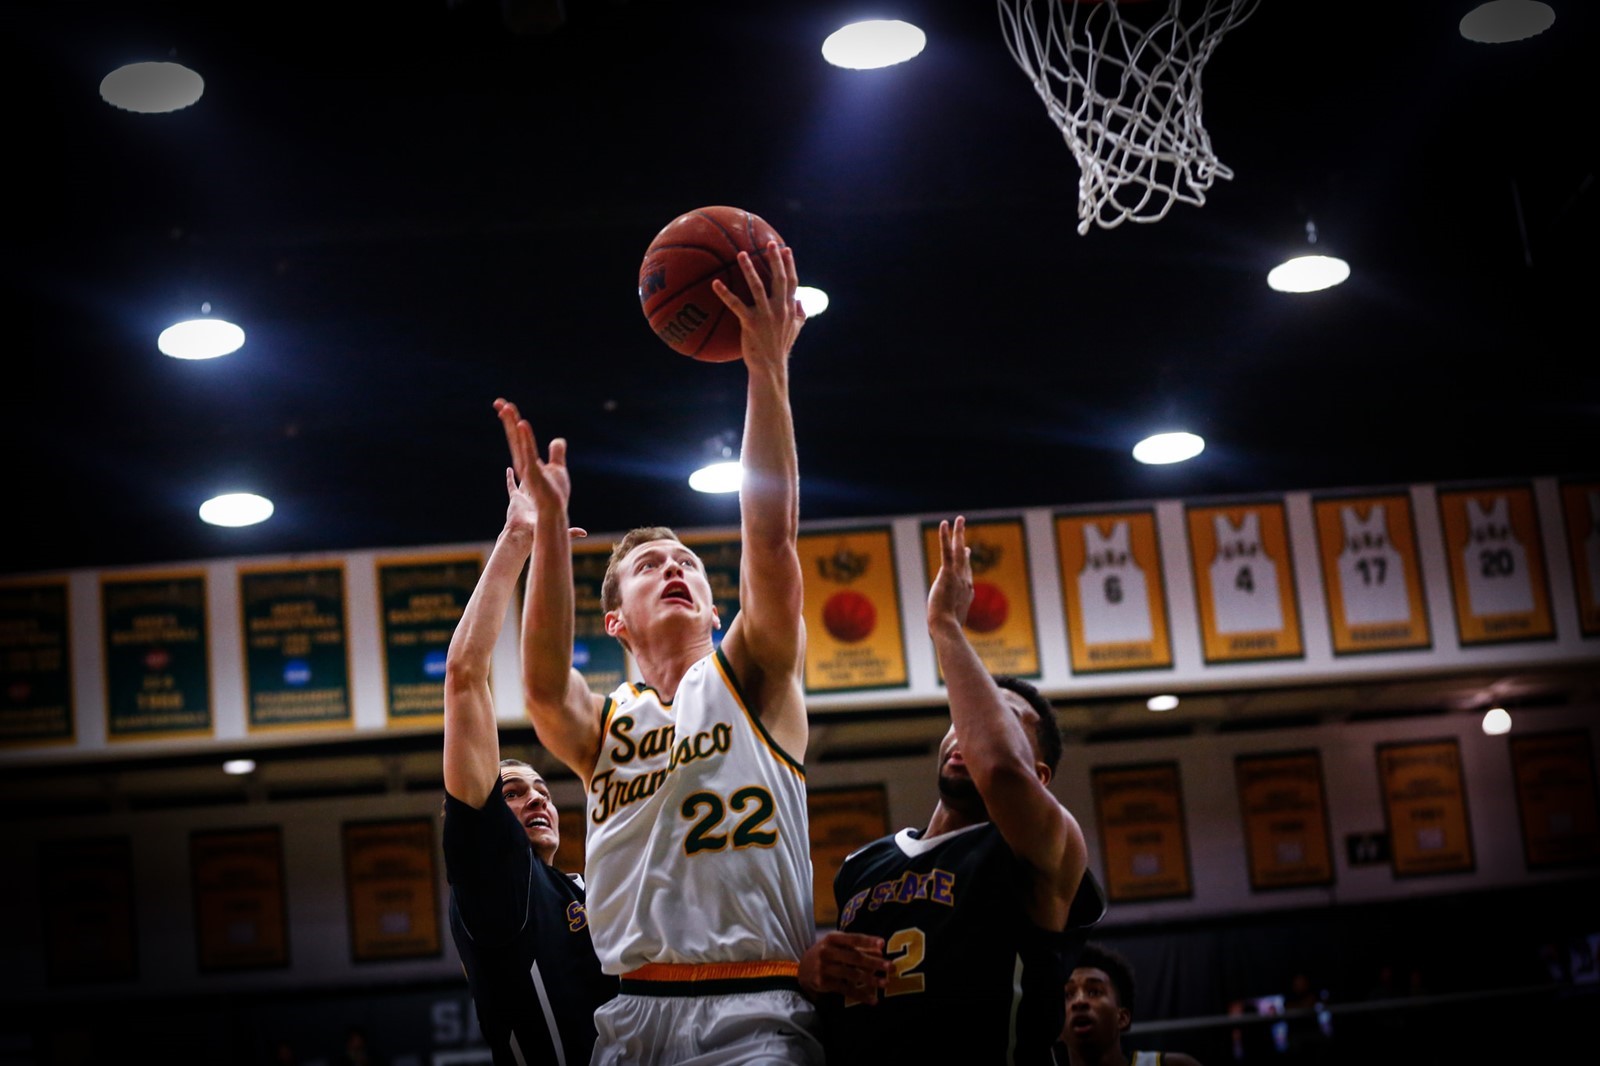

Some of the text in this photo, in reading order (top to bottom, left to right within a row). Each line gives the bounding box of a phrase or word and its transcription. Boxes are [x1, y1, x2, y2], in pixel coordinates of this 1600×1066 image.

[1356, 557, 1387, 586] 17
[1480, 550, 1515, 578] 20
[1104, 574, 1123, 604] 6
[1235, 565, 1254, 594] 4
[609, 715, 677, 763] San
[680, 785, 780, 858] 22
